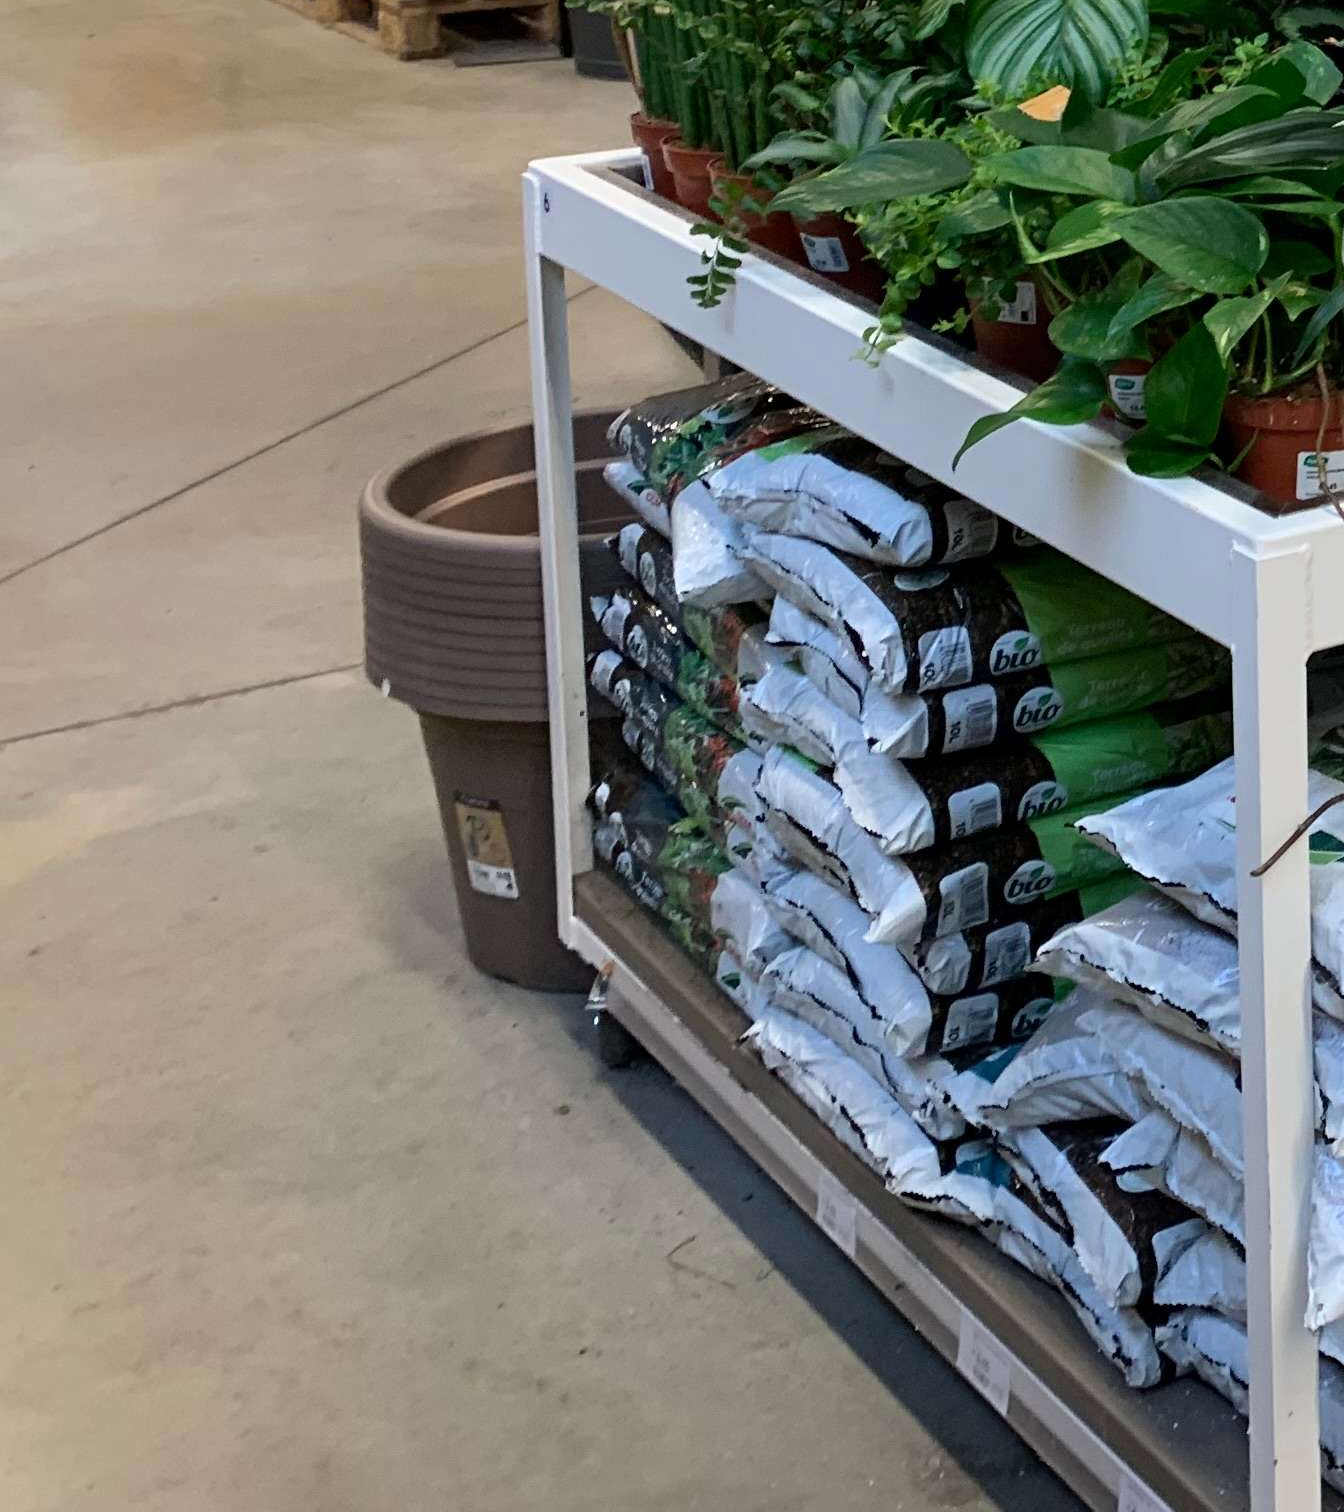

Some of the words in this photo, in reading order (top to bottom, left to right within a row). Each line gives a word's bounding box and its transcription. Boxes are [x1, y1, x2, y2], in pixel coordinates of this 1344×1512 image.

[993, 647, 1042, 674] bio
[1015, 701, 1062, 728] bio
[1023, 796, 1066, 818] bio
[1007, 875, 1053, 898] bio
